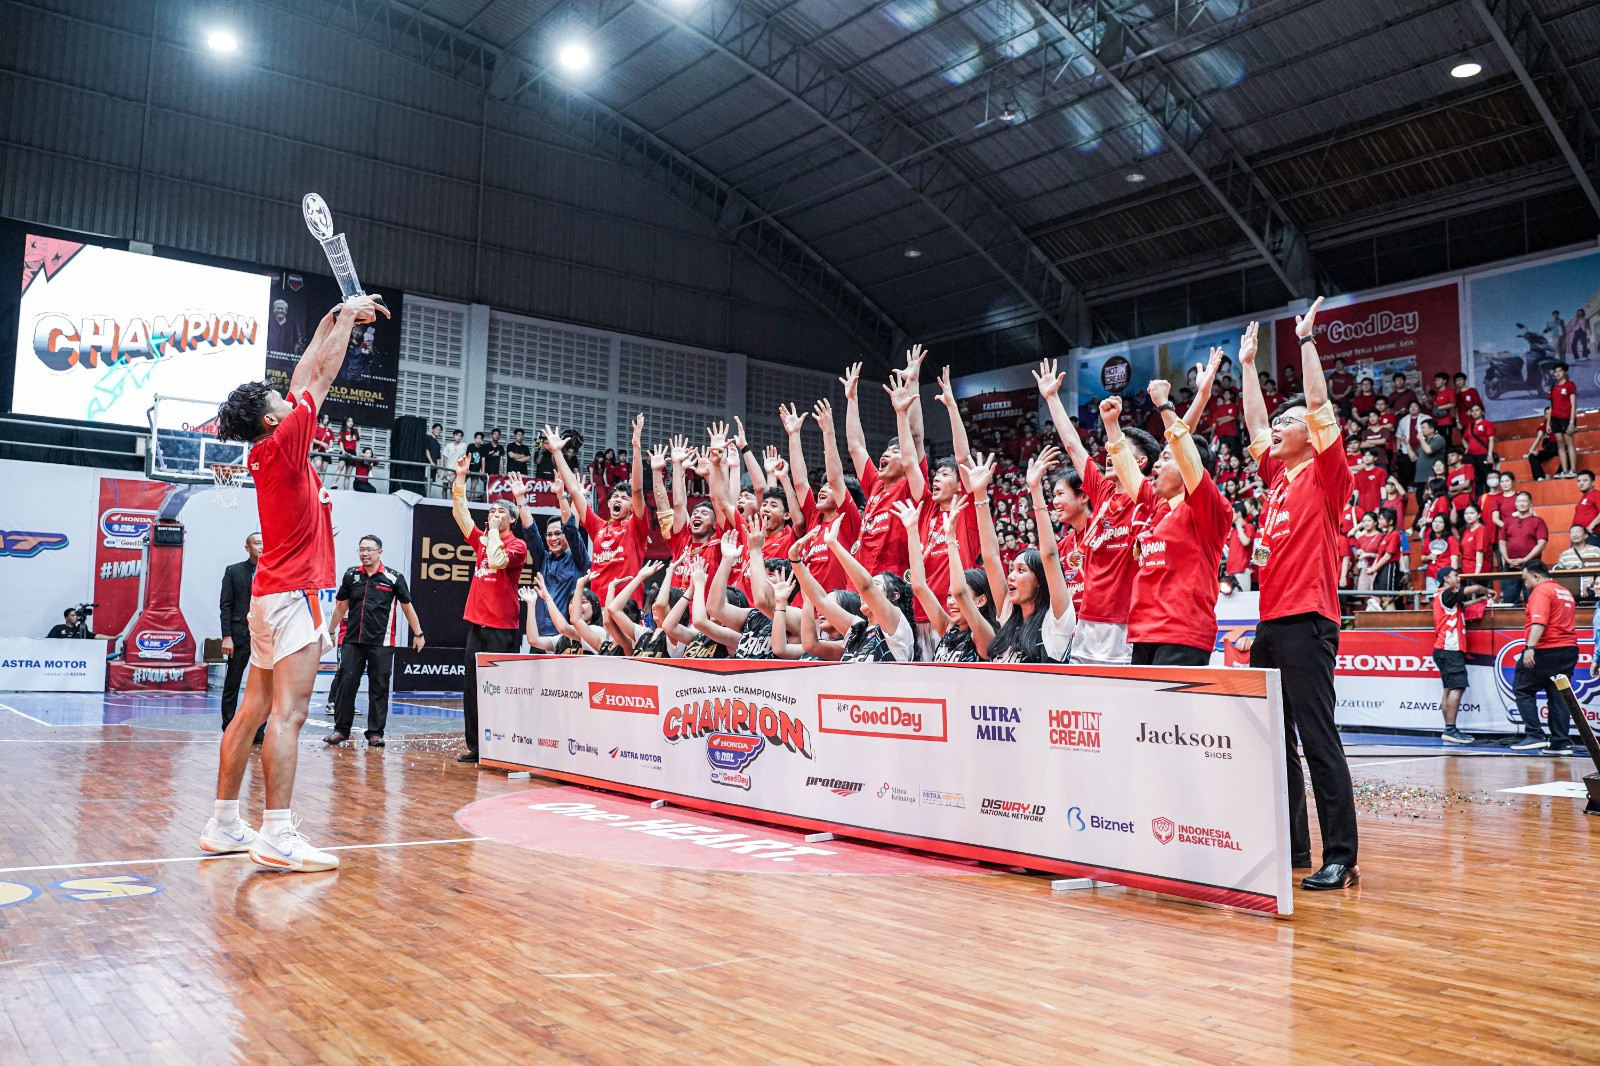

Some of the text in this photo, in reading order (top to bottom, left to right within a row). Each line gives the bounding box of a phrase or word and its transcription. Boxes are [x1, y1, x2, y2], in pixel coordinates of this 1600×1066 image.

[33, 313, 258, 371] CHAMPION
[350, 388, 384, 400] MEDAL
[120, 524, 136, 532] DBL
[421, 563, 470, 581] ICE
[2, 660, 87, 669] ASTRA MOTOR
[403, 664, 466, 675] AZAWEAR
[1334, 654, 1441, 671] HONDA
[540, 688, 583, 699] AZAWEAR.COM
[675, 686, 706, 698] CENTRAL
[708, 685, 726, 694] JAVA
[733, 686, 797, 706] CHAMPIONSHIP
[605, 695, 656, 709] HONDA
[971, 705, 1021, 723] ULTRA
[663, 698, 810, 757] CHAMPION
[977, 725, 1017, 742] MILK
[1049, 729, 1101, 748] CREAM
[1136, 722, 1232, 749] Jackson
[720, 741, 749, 749] HONDA
[620, 750, 662, 763] ASTRA MOTOR
[721, 752, 735, 762] DBL
[1204, 751, 1232, 760] SHOES
[806, 776, 863, 791] proteam
[922, 791, 941, 799] MITRA
[981, 798, 1046, 815] DISWAY.ID
[980, 808, 1044, 822] NATIONAL NETWORK
[1091, 815, 1135, 833] Biznet
[528, 803, 838, 861] One HEART.
[1178, 825, 1231, 840] INDONESIA
[1178, 833, 1242, 851] BASKETBALL
